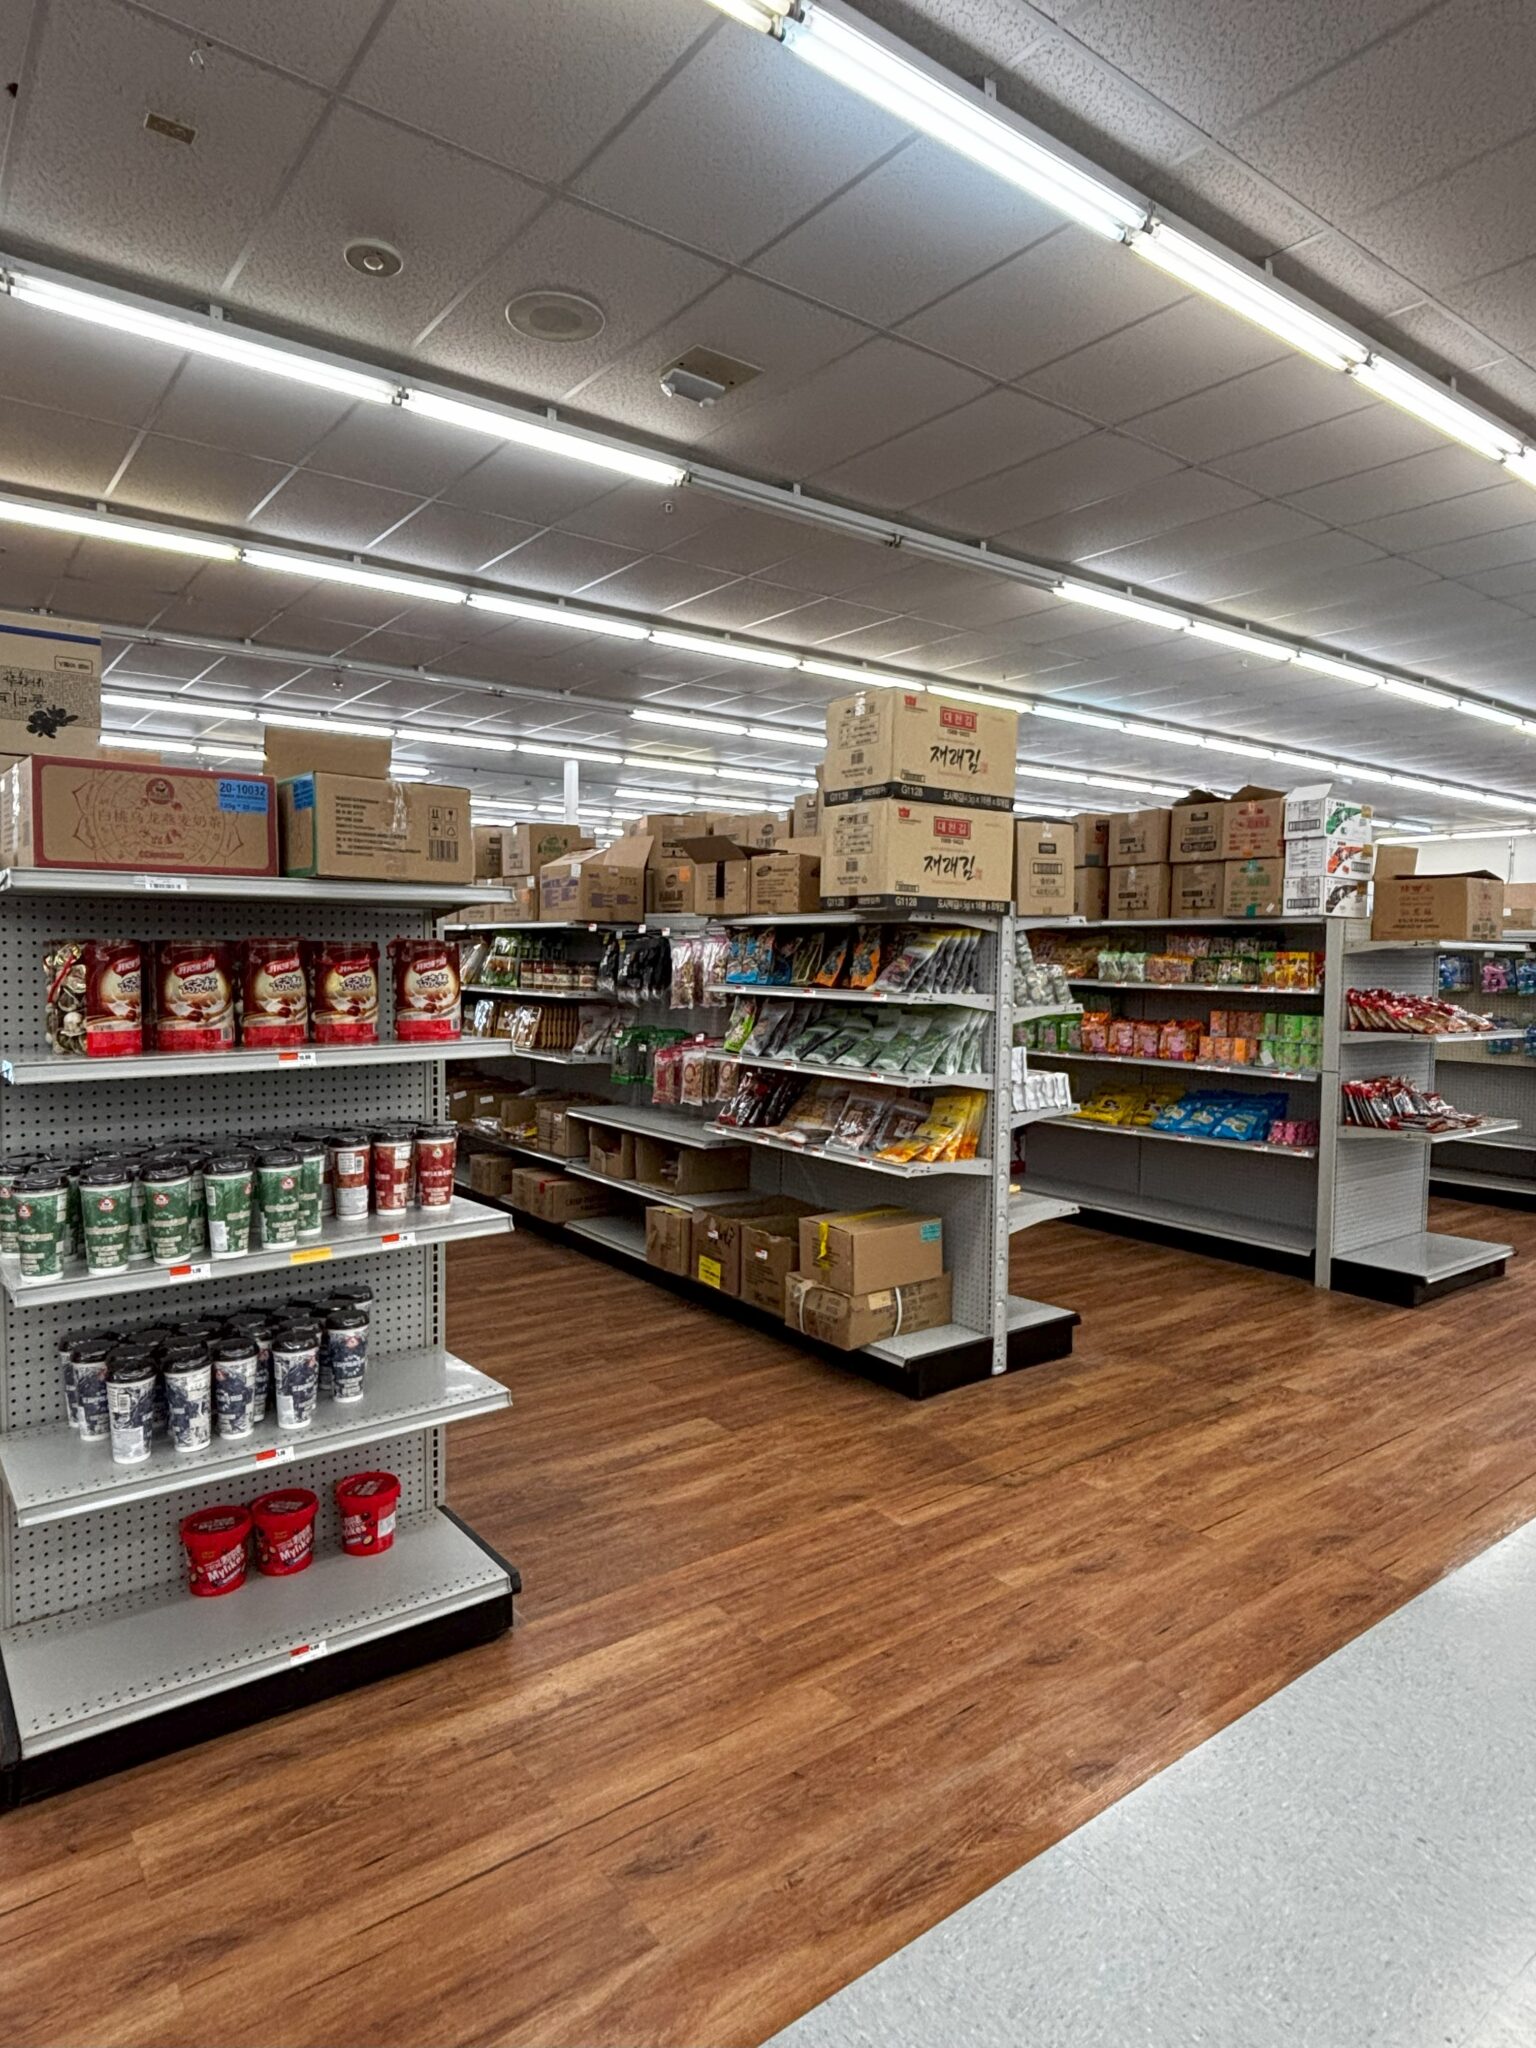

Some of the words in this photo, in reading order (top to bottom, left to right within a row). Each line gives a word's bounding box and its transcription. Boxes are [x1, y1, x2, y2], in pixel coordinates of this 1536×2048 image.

[930, 745, 981, 775] 재래김
[219, 782, 266, 796] 20-10032
[923, 854, 975, 881] 재래김
